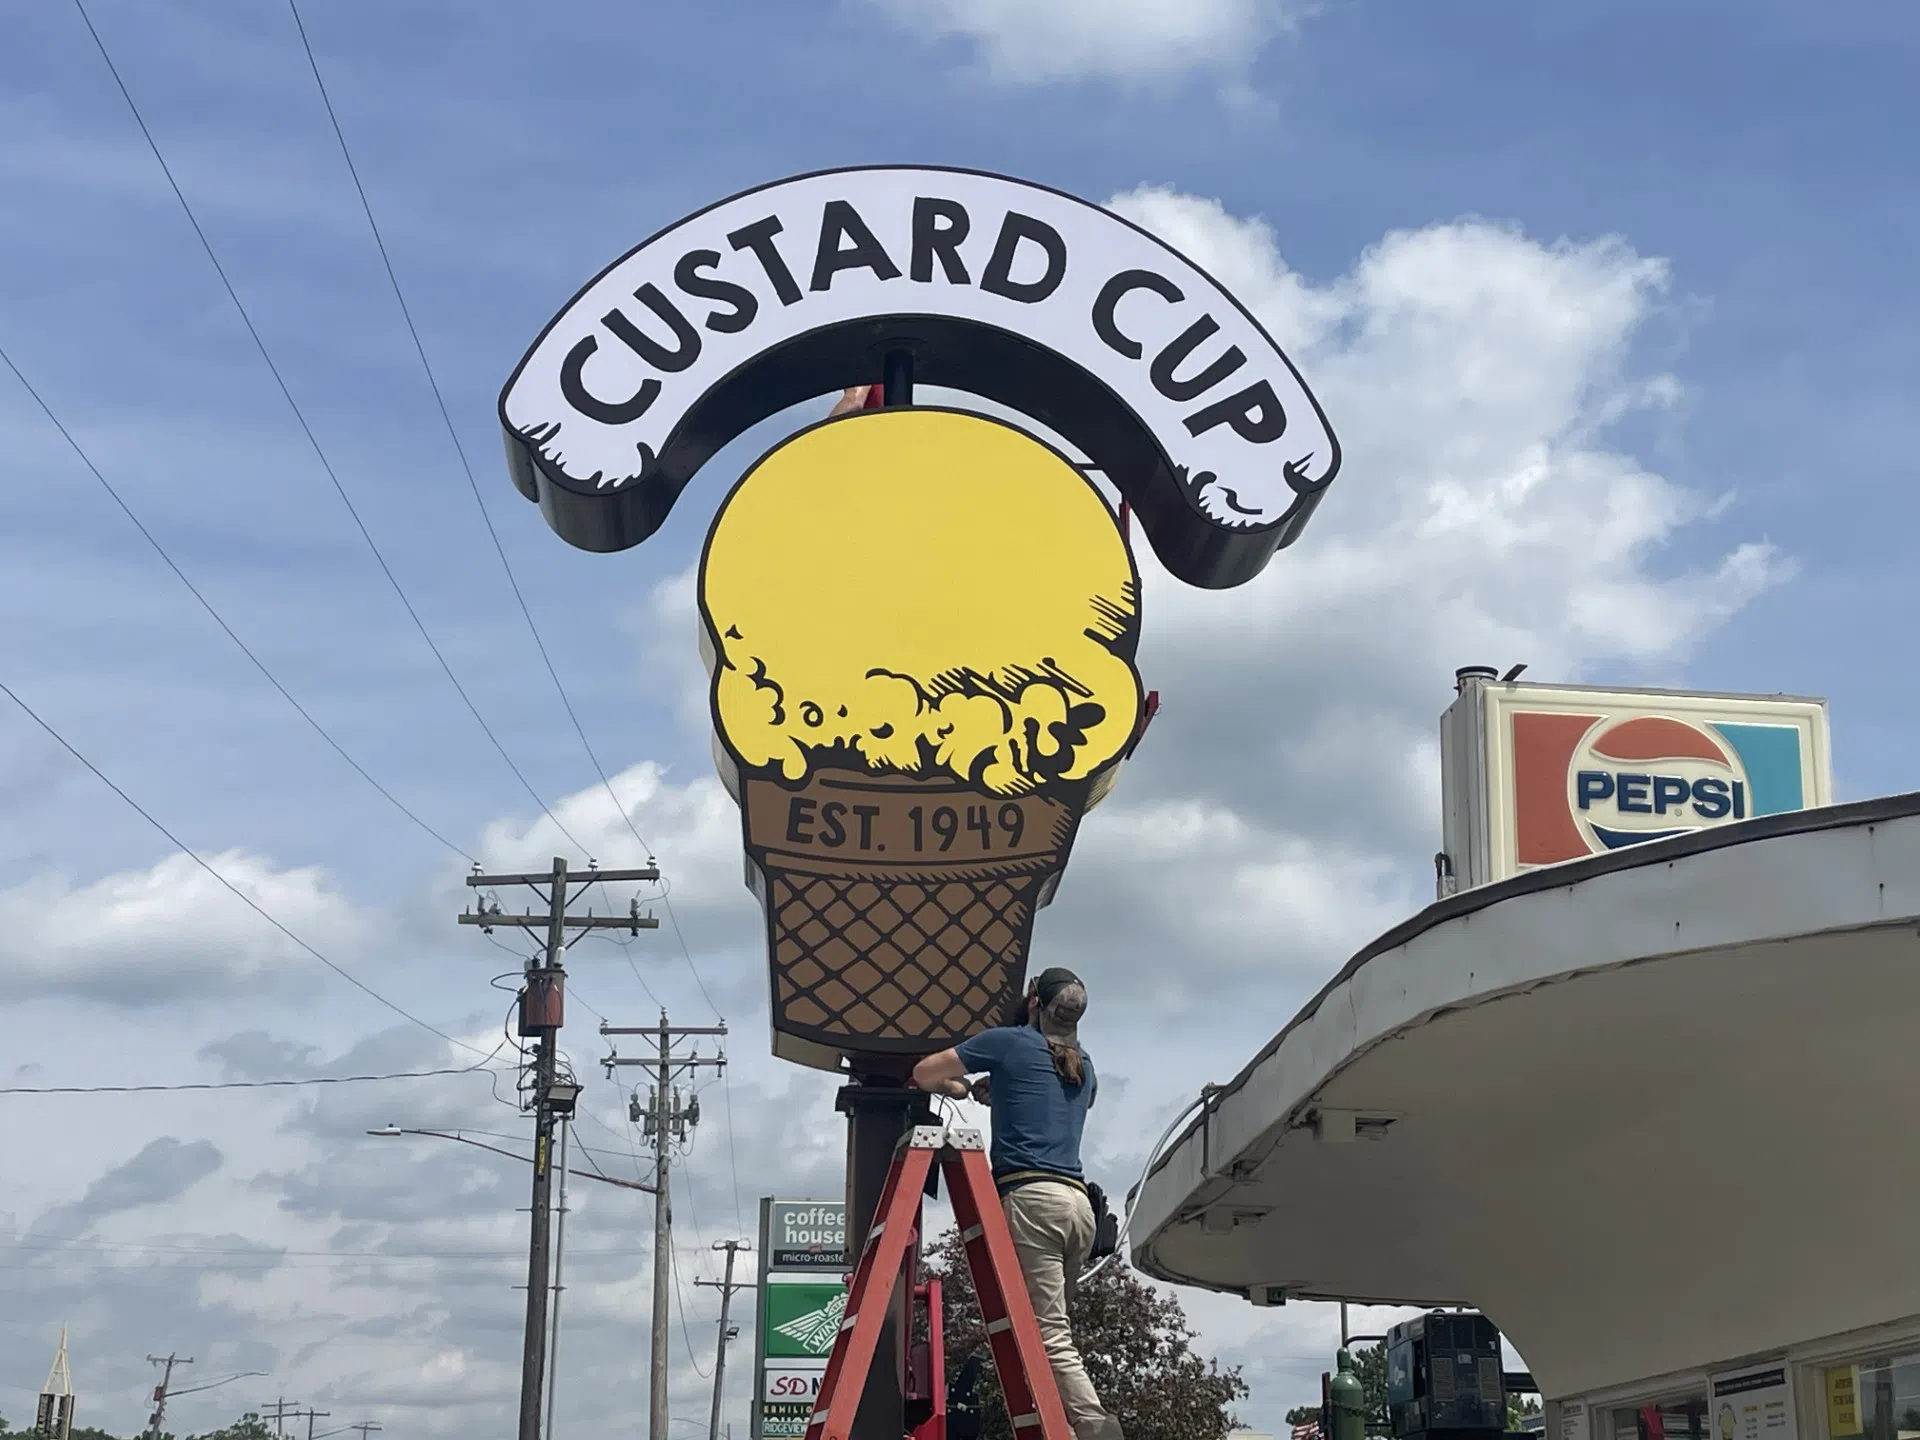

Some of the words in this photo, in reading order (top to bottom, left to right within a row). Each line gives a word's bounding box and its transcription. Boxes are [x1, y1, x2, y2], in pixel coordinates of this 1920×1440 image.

[560, 196, 1067, 424] CUSTARD
[1092, 269, 1287, 443] CUP
[1577, 771, 1745, 819] PEPSI
[786, 797, 886, 852] EST.
[909, 803, 1025, 852] 1949
[784, 1208, 845, 1226] coffee
[785, 1221, 845, 1244] house
[770, 1376, 808, 1396] SD
